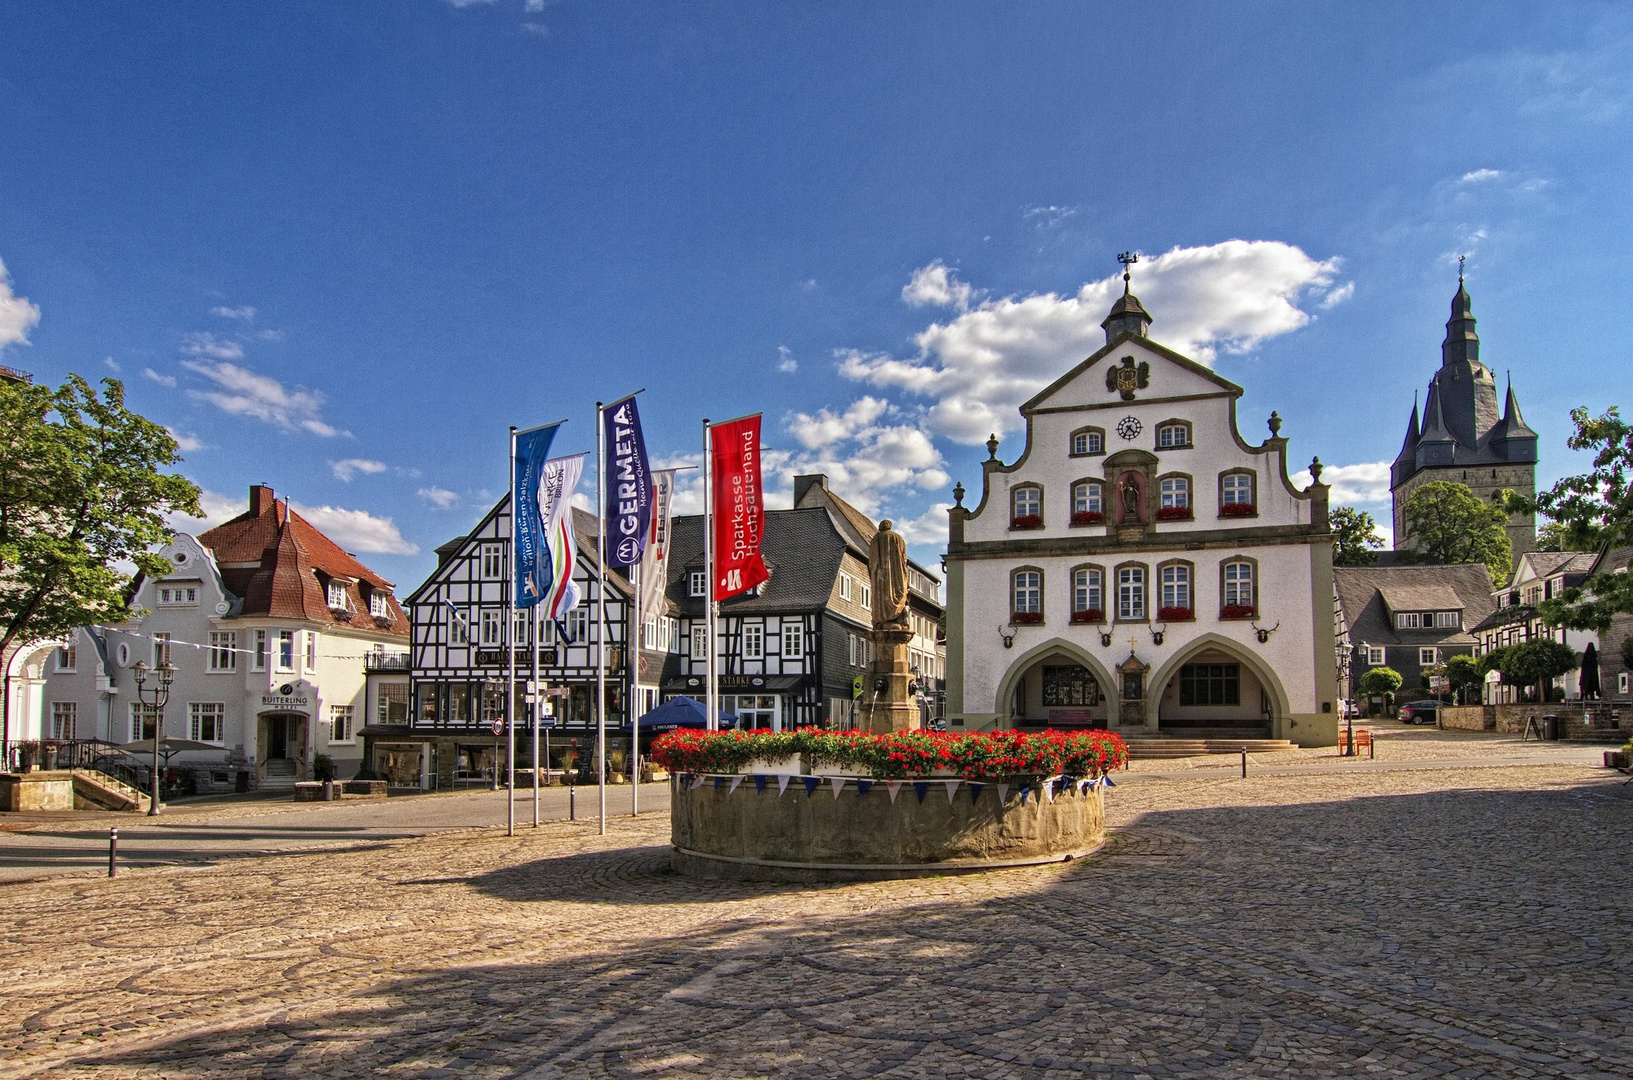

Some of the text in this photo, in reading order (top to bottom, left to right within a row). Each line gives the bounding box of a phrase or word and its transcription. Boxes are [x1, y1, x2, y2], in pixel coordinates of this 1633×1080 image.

[554, 468, 565, 498] BRILON
[613, 404, 638, 535] GERMETA
[742, 430, 758, 557] Hochsauerland
[541, 469, 558, 569] STWERKE
[656, 483, 667, 543] EGGER
[731, 475, 747, 560] Sparkasse
[513, 652, 542, 661] STAR
[722, 676, 751, 685] STARKE
[262, 696, 308, 704] BUITERLING
